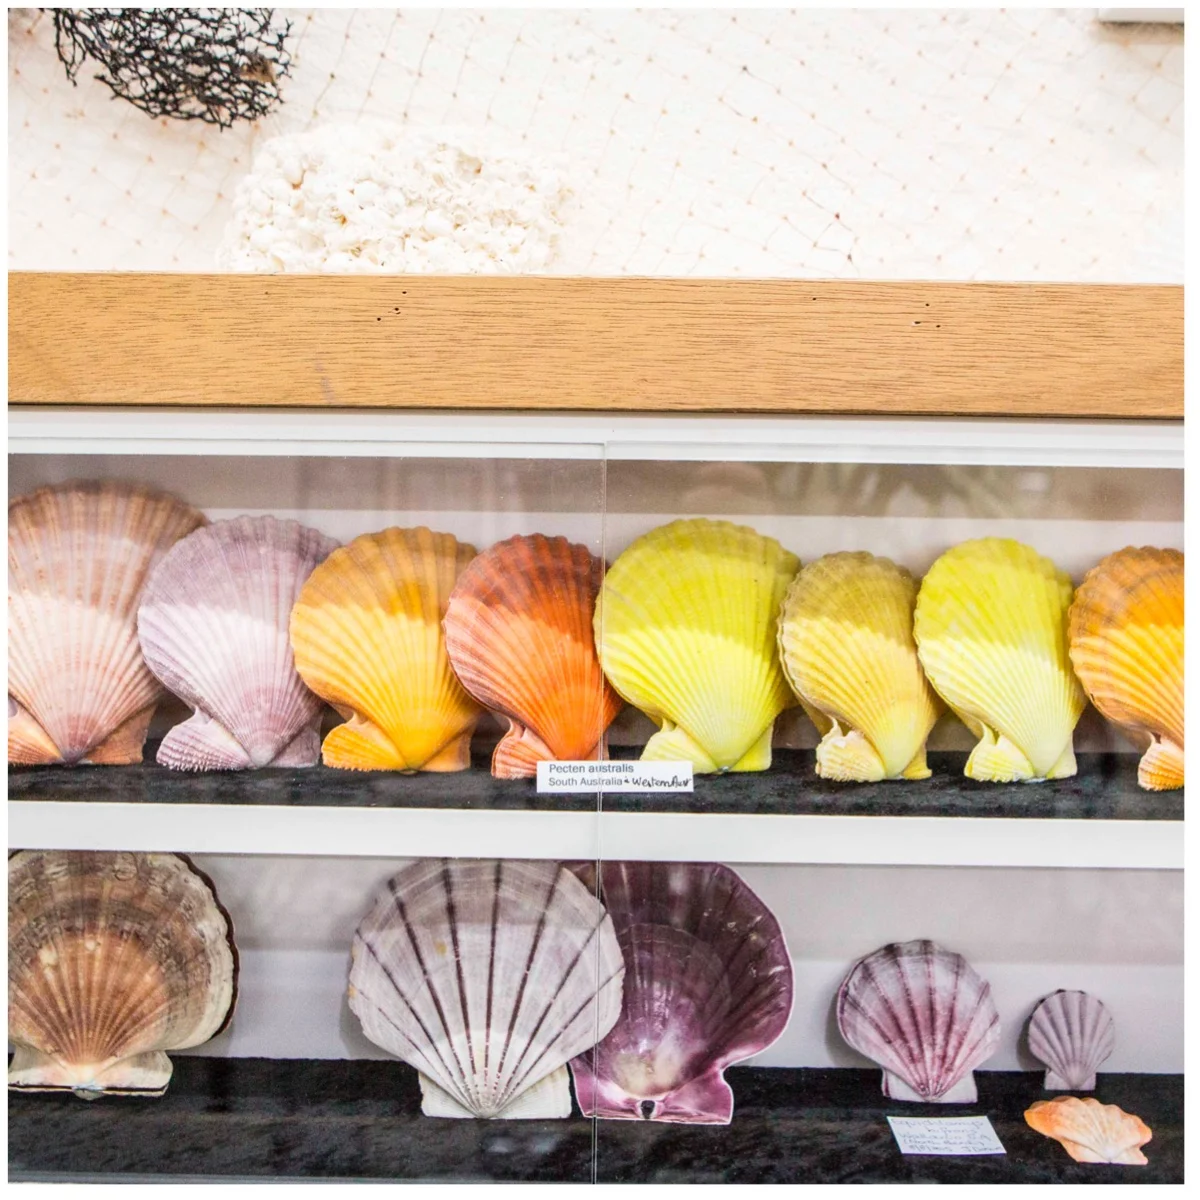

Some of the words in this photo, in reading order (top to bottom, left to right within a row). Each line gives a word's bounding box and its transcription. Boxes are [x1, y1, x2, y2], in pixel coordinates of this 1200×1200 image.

[549, 763, 585, 773] Pecten
[588, 763, 634, 773] australis
[548, 776, 577, 786] South
[580, 776, 623, 786] Australia
